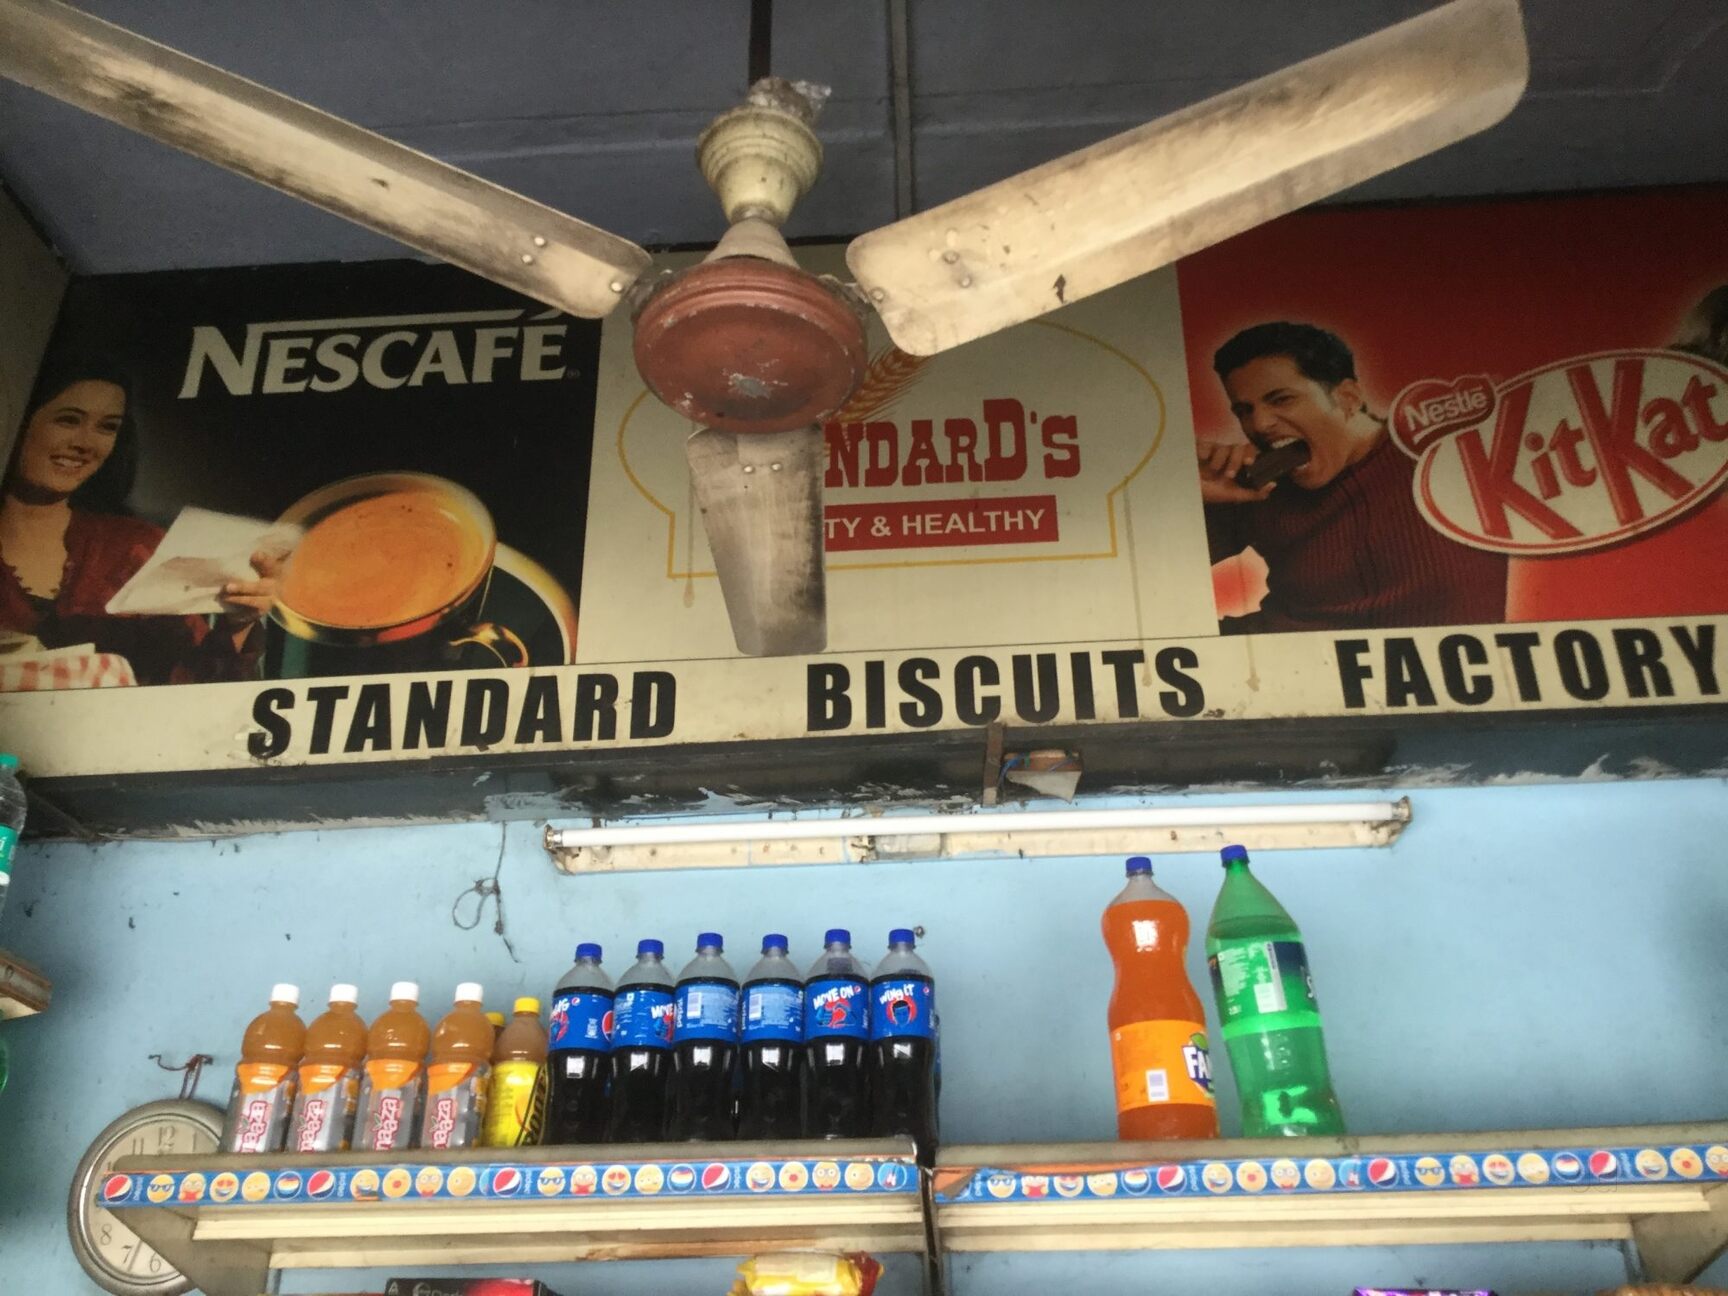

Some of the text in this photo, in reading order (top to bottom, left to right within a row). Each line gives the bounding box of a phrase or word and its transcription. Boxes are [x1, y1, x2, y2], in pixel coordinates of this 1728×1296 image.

[177, 308, 568, 399] NESCAFÉ
[1404, 386, 1487, 431] Nestlé
[870, 516, 891, 537] &
[902, 509, 1045, 535] HEALTHY
[247, 624, 1720, 759] STANDARD BISCUITS FACTORY
[158, 1126, 176, 1148] 12
[100, 1223, 112, 1245] 8
[121, 1244, 133, 1264] 7
[150, 1252, 162, 1273] 6
